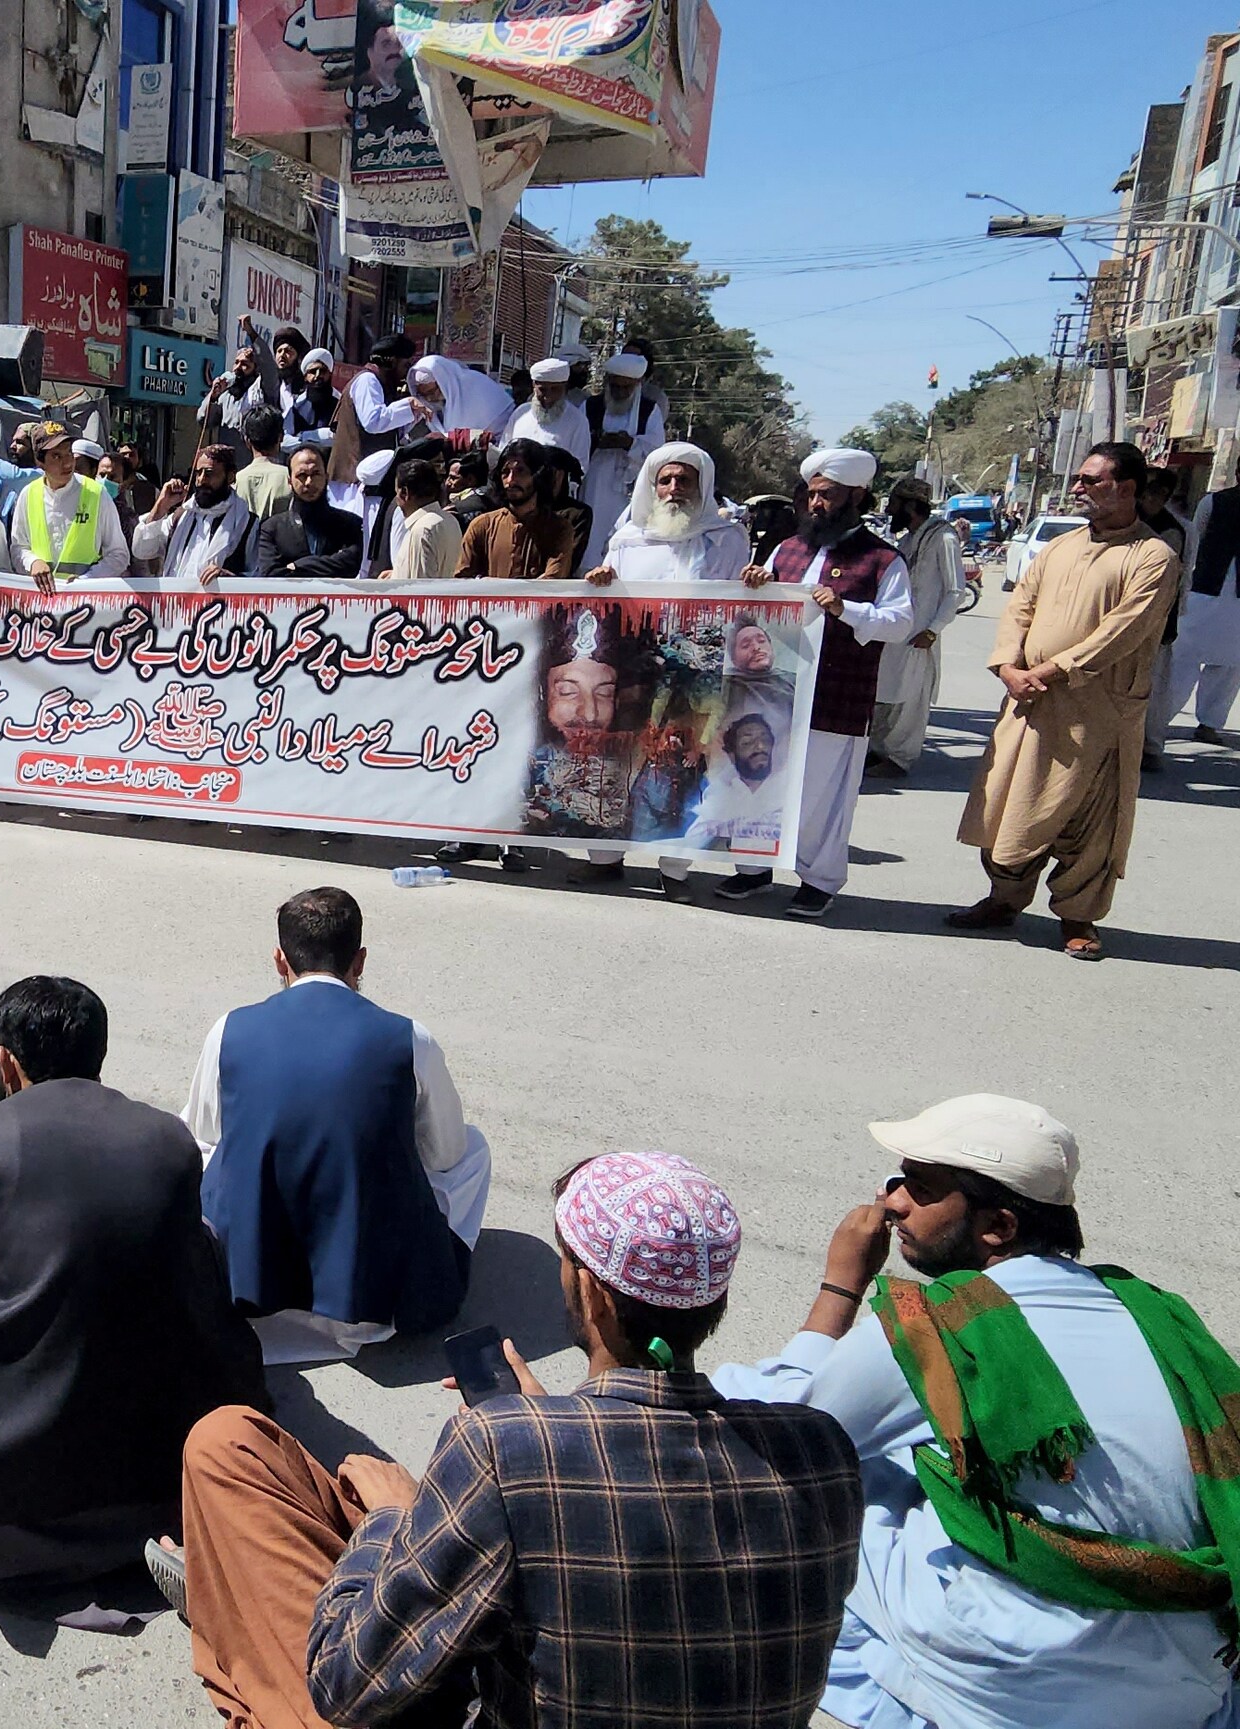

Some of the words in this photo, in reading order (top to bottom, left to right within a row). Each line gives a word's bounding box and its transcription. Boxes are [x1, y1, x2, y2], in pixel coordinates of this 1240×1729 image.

[28, 230, 53, 251] Shah
[55, 237, 93, 262] Panaflex
[95, 249, 124, 270] Printer
[40, 272, 75, 310] برادرز
[78, 271, 122, 337] شاہ
[247, 266, 302, 324] UNIQUE
[143, 375, 189, 397] PHARMACY
[144, 345, 189, 376] Life
[75, 512, 90, 524] TLP
[47, 607, 94, 660] کے
[93, 608, 149, 671] حسی
[130, 625, 178, 679] بے
[178, 603, 222, 674] کی
[206, 608, 326, 684] حکمرانوں
[339, 611, 456, 674] مستونگ
[438, 620, 521, 680] سانحہ
[307, 636, 339, 690] پر
[223, 687, 292, 765] النبی
[289, 714, 368, 772] میلاد
[360, 710, 498, 783] شہدائے
[21, 755, 85, 785] بلوچستان
